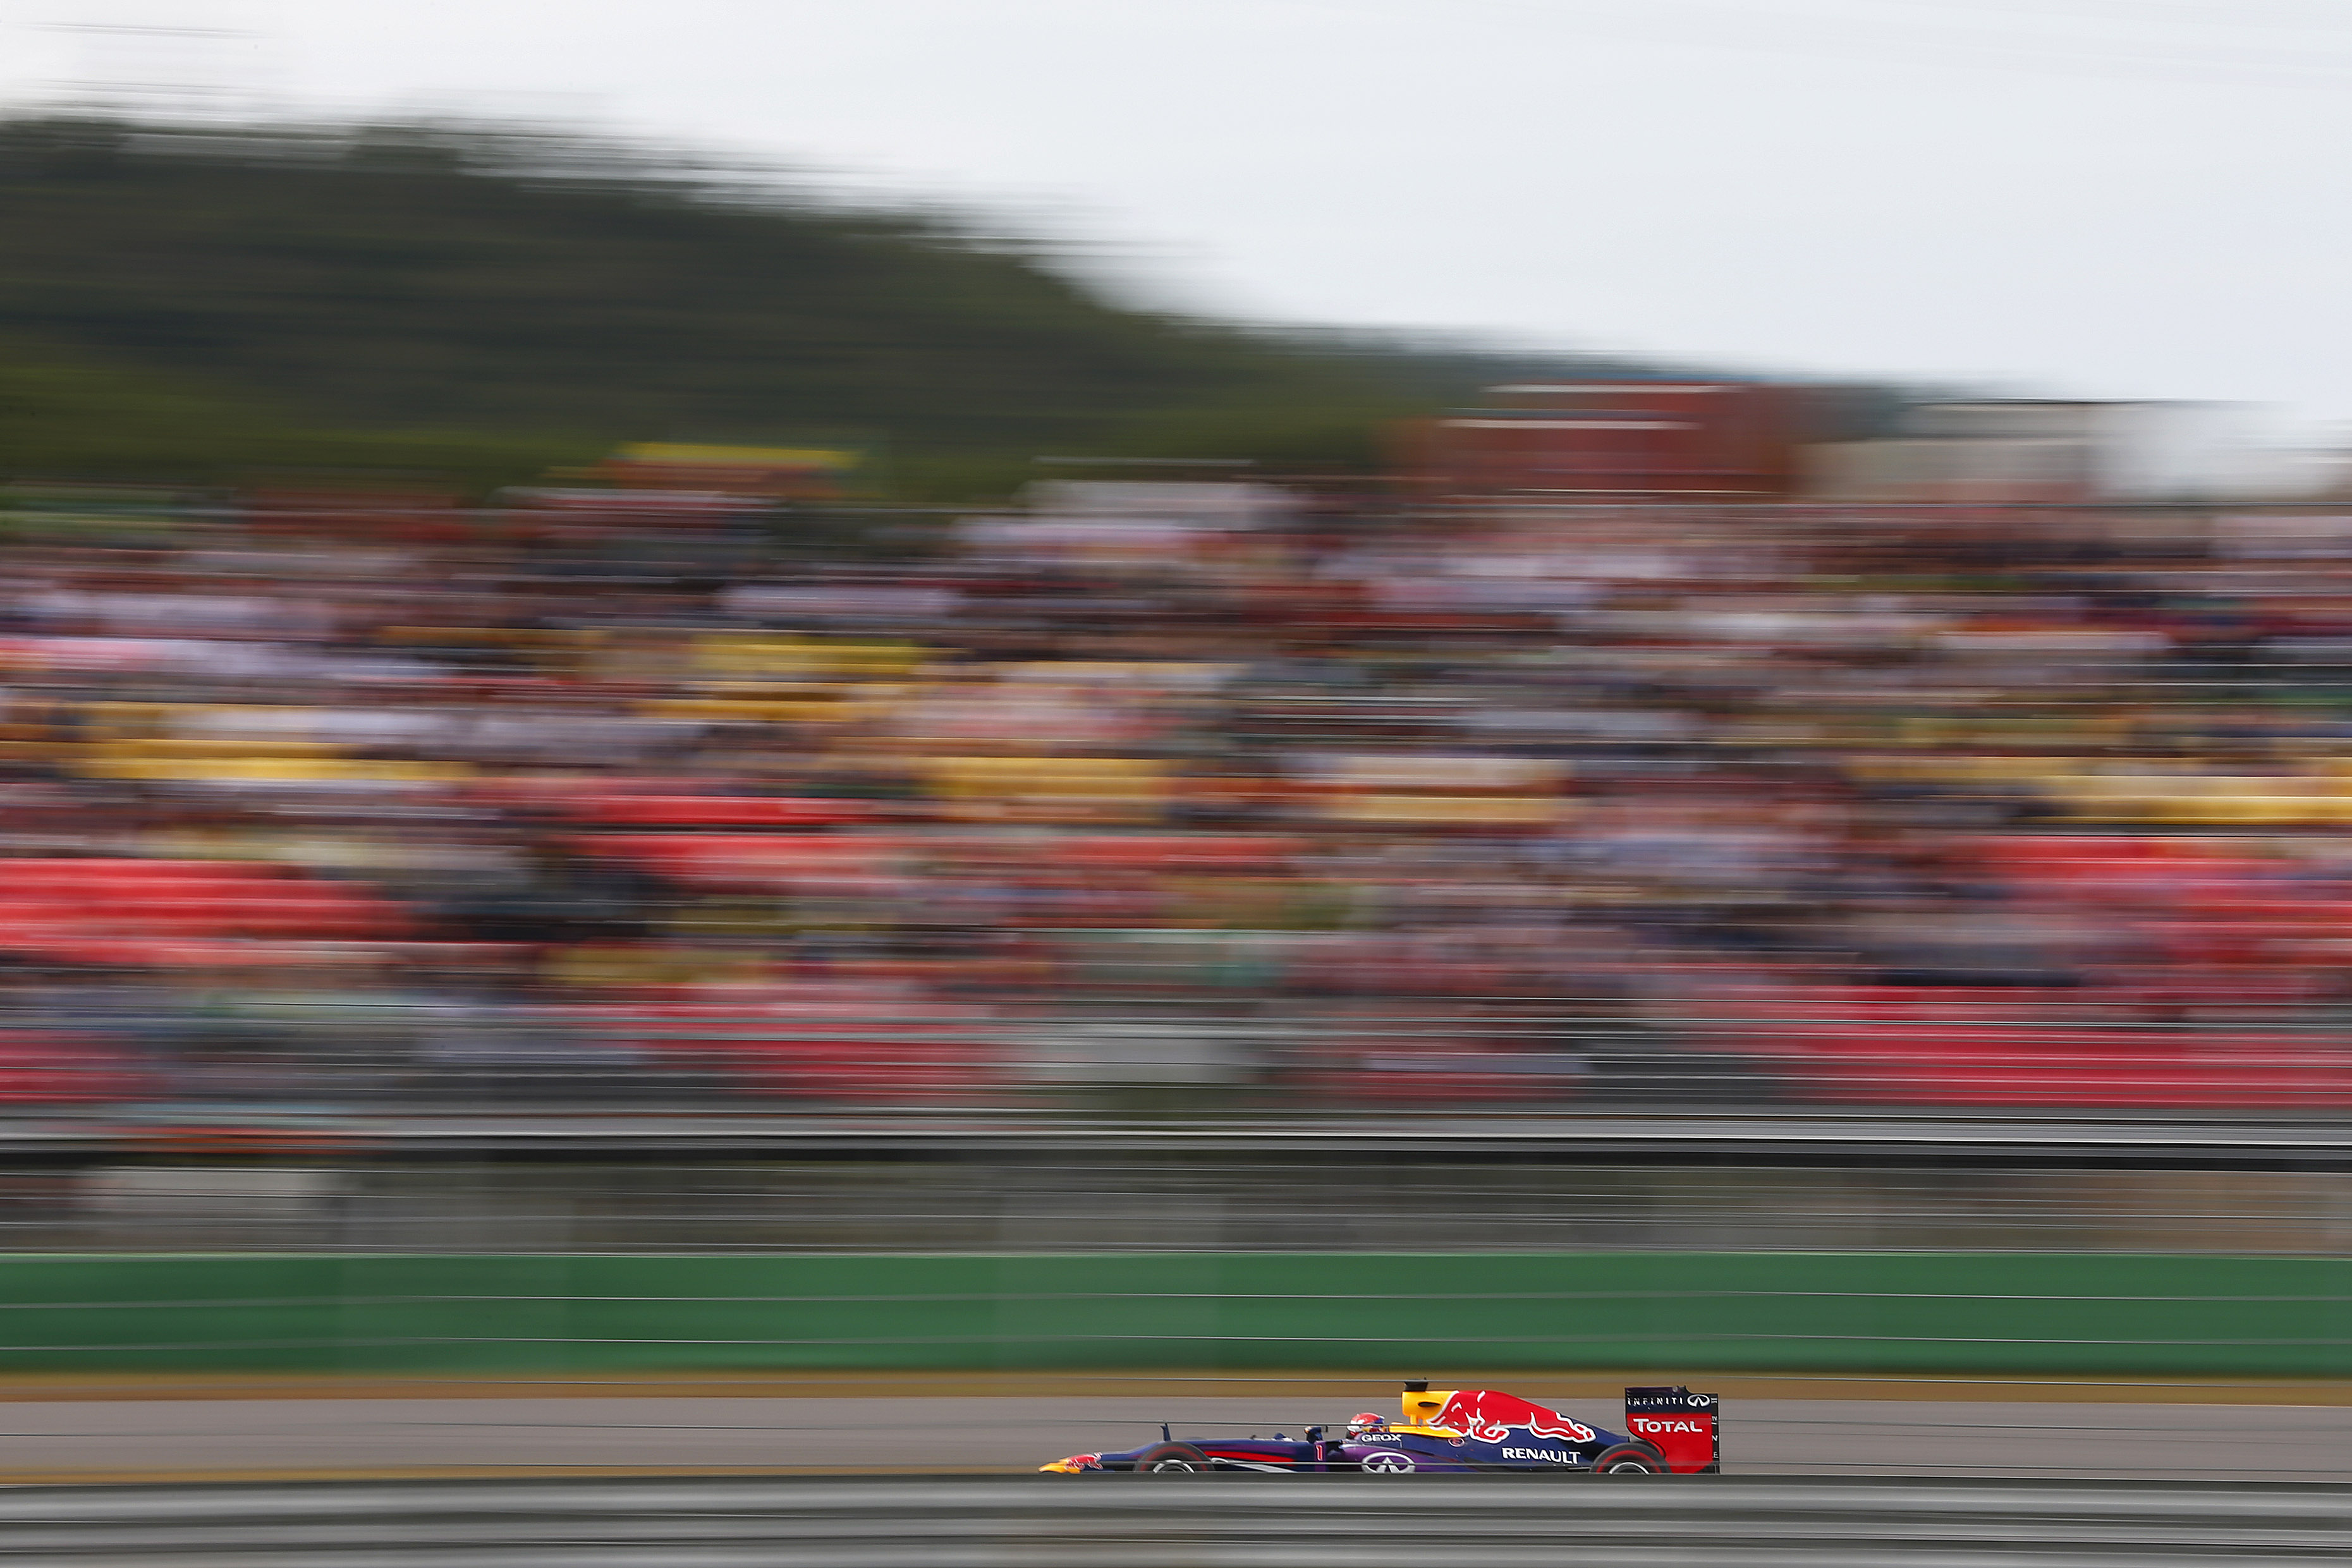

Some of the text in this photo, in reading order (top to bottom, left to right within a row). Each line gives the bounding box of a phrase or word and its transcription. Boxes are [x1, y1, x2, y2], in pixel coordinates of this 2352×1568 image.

[1627, 1397, 1683, 1406] INFINITI
[1633, 1418, 1703, 1433] TOTAL
[1361, 1434, 1401, 1442] GEOX
[1501, 1447, 1581, 1464] RENAULT
